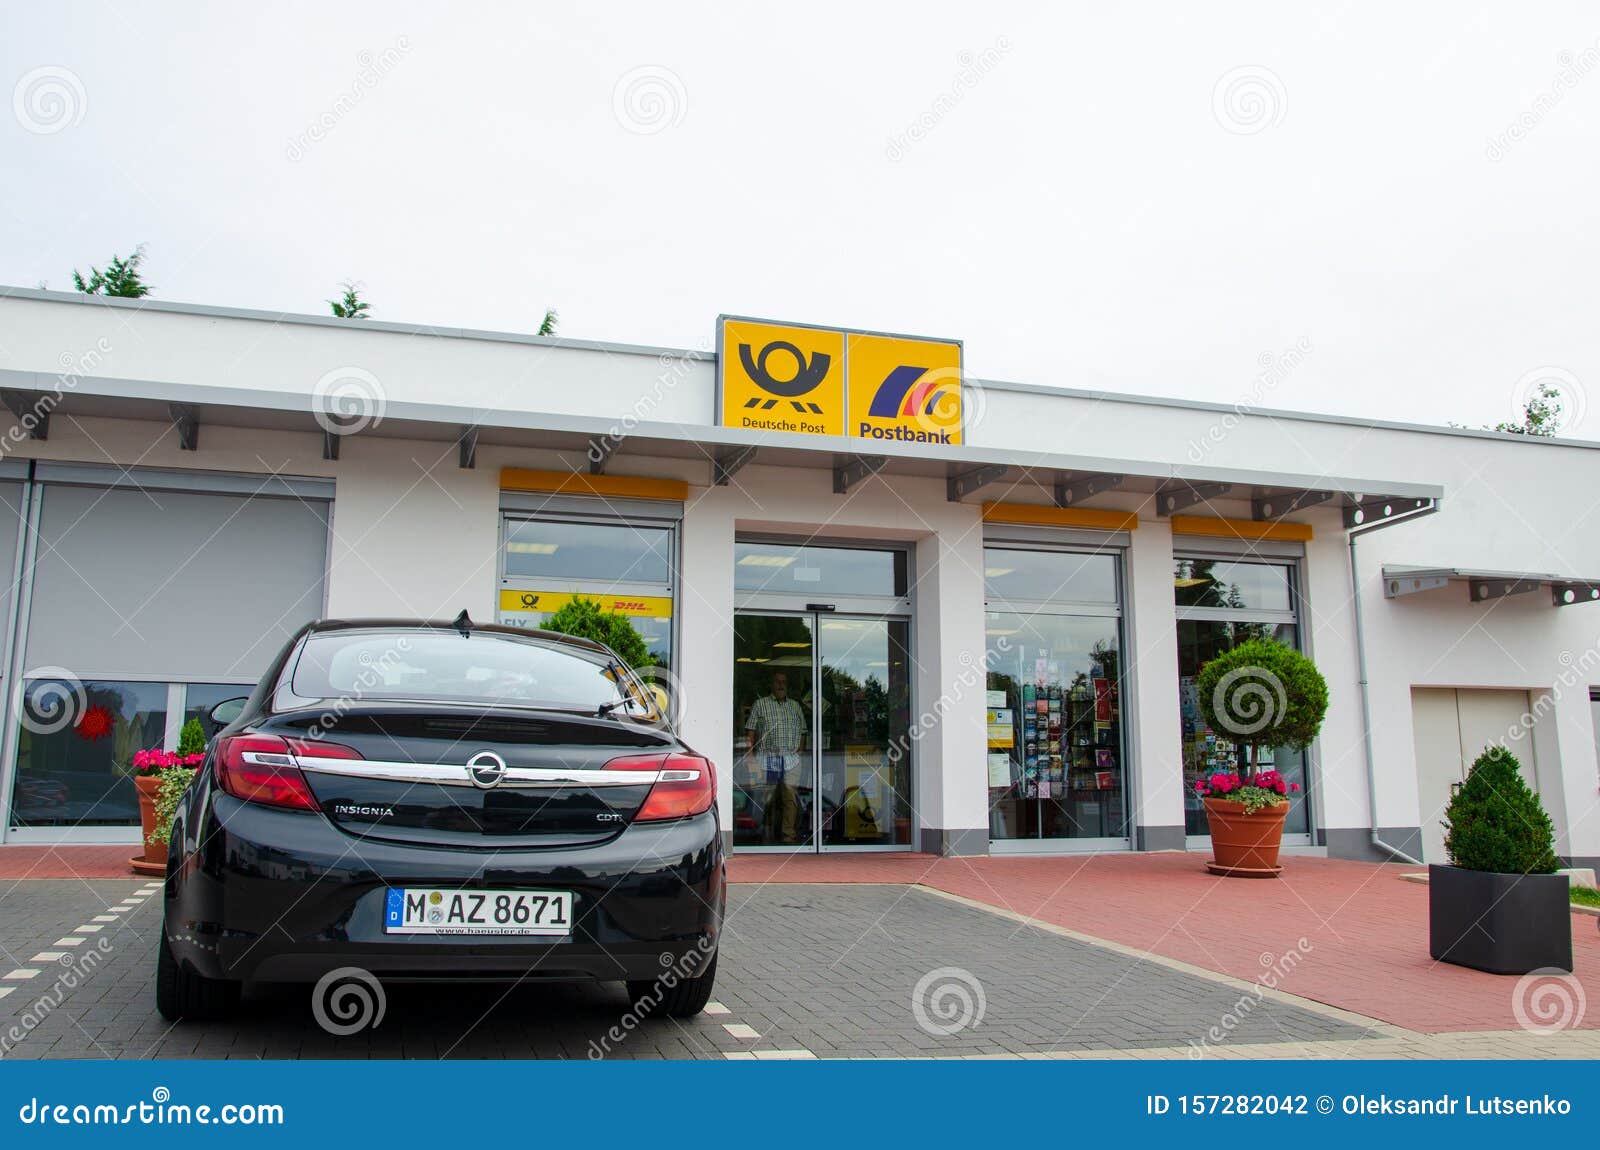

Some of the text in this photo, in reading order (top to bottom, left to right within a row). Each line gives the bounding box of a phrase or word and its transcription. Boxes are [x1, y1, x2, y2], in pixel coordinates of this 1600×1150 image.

[742, 417, 826, 434] Deutsche Post
[859, 422, 952, 445] Postbank
[612, 601, 648, 611] DHL
[335, 804, 394, 817] INSIGNIA
[390, 893, 567, 924] D M AZ 8671
